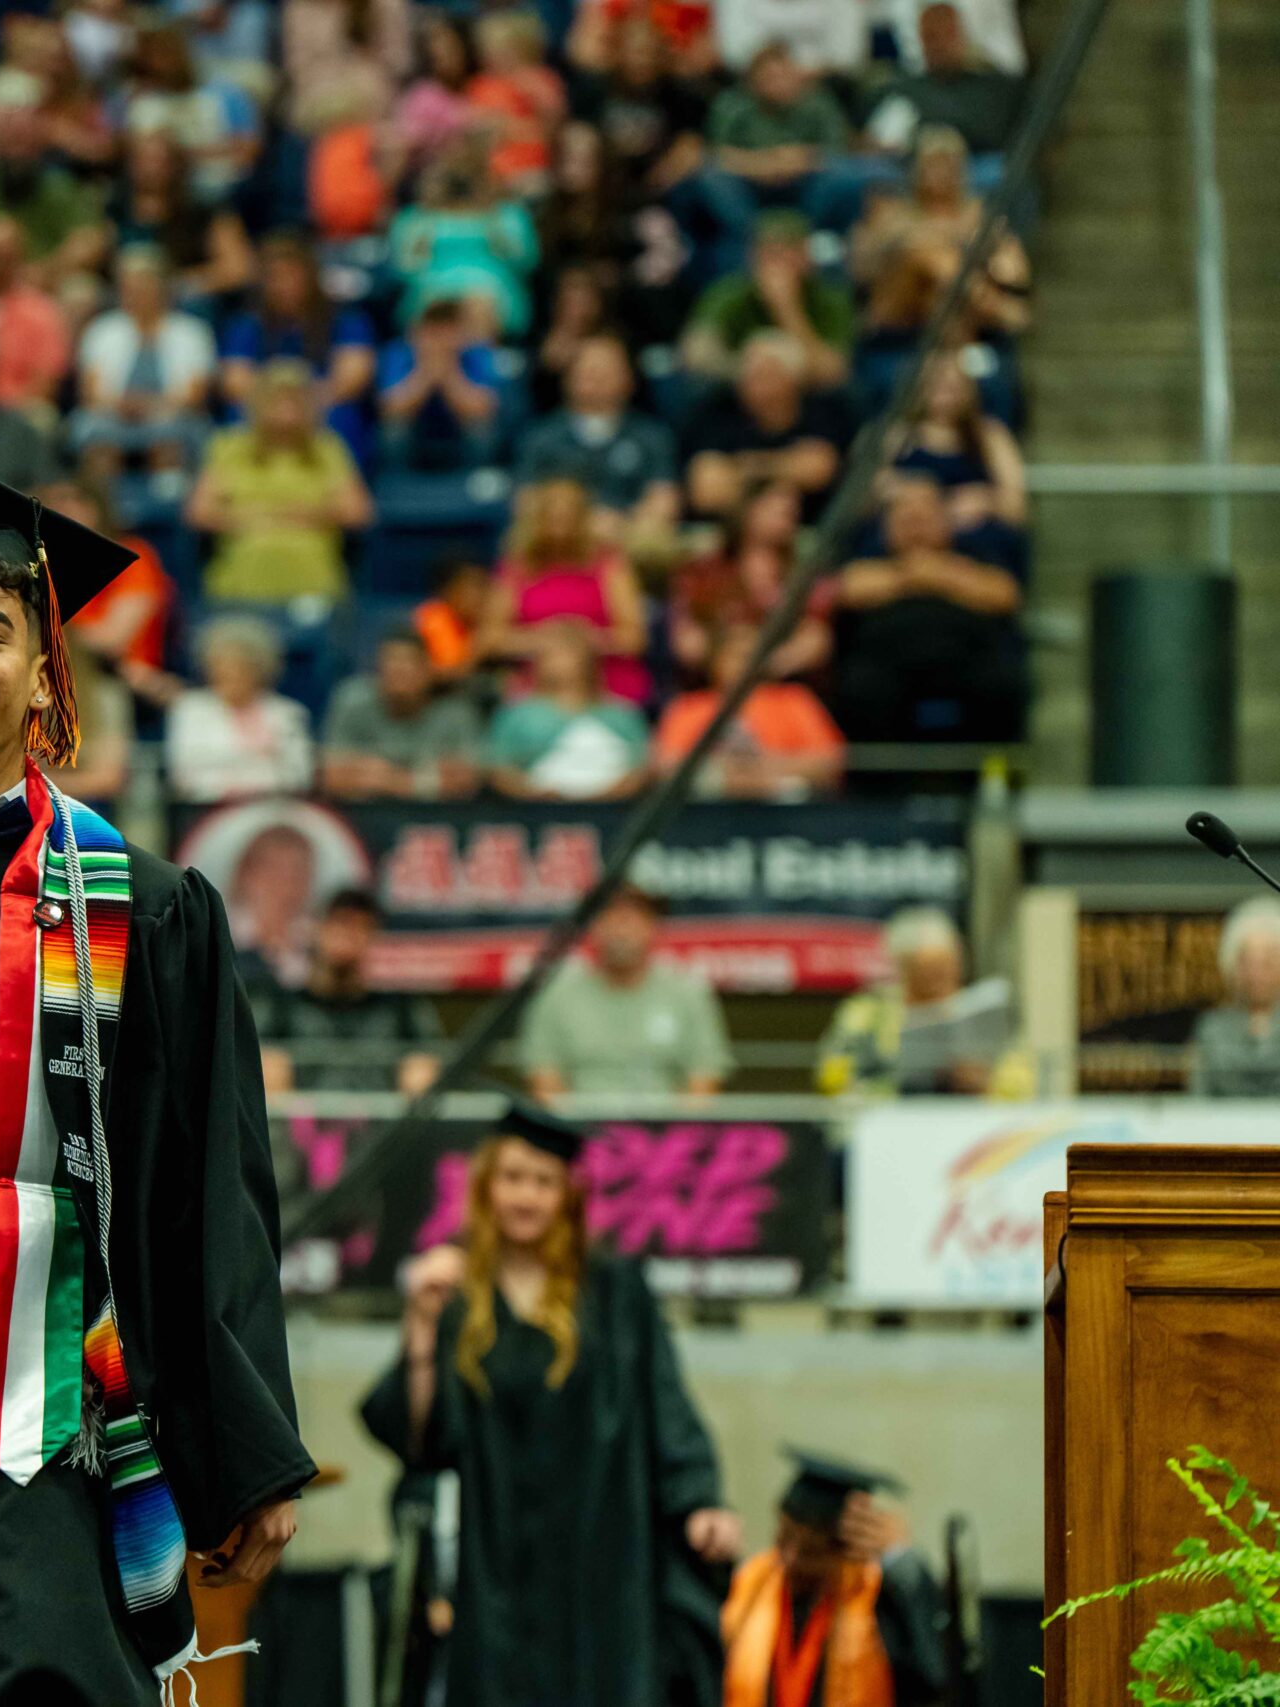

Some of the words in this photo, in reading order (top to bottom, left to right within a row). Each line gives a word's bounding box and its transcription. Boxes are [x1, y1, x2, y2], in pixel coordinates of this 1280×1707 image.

[63, 1045, 87, 1061] FIRS
[48, 1059, 106, 1080] GENERAN
[62, 1142, 95, 1167] BIOMEDIC
